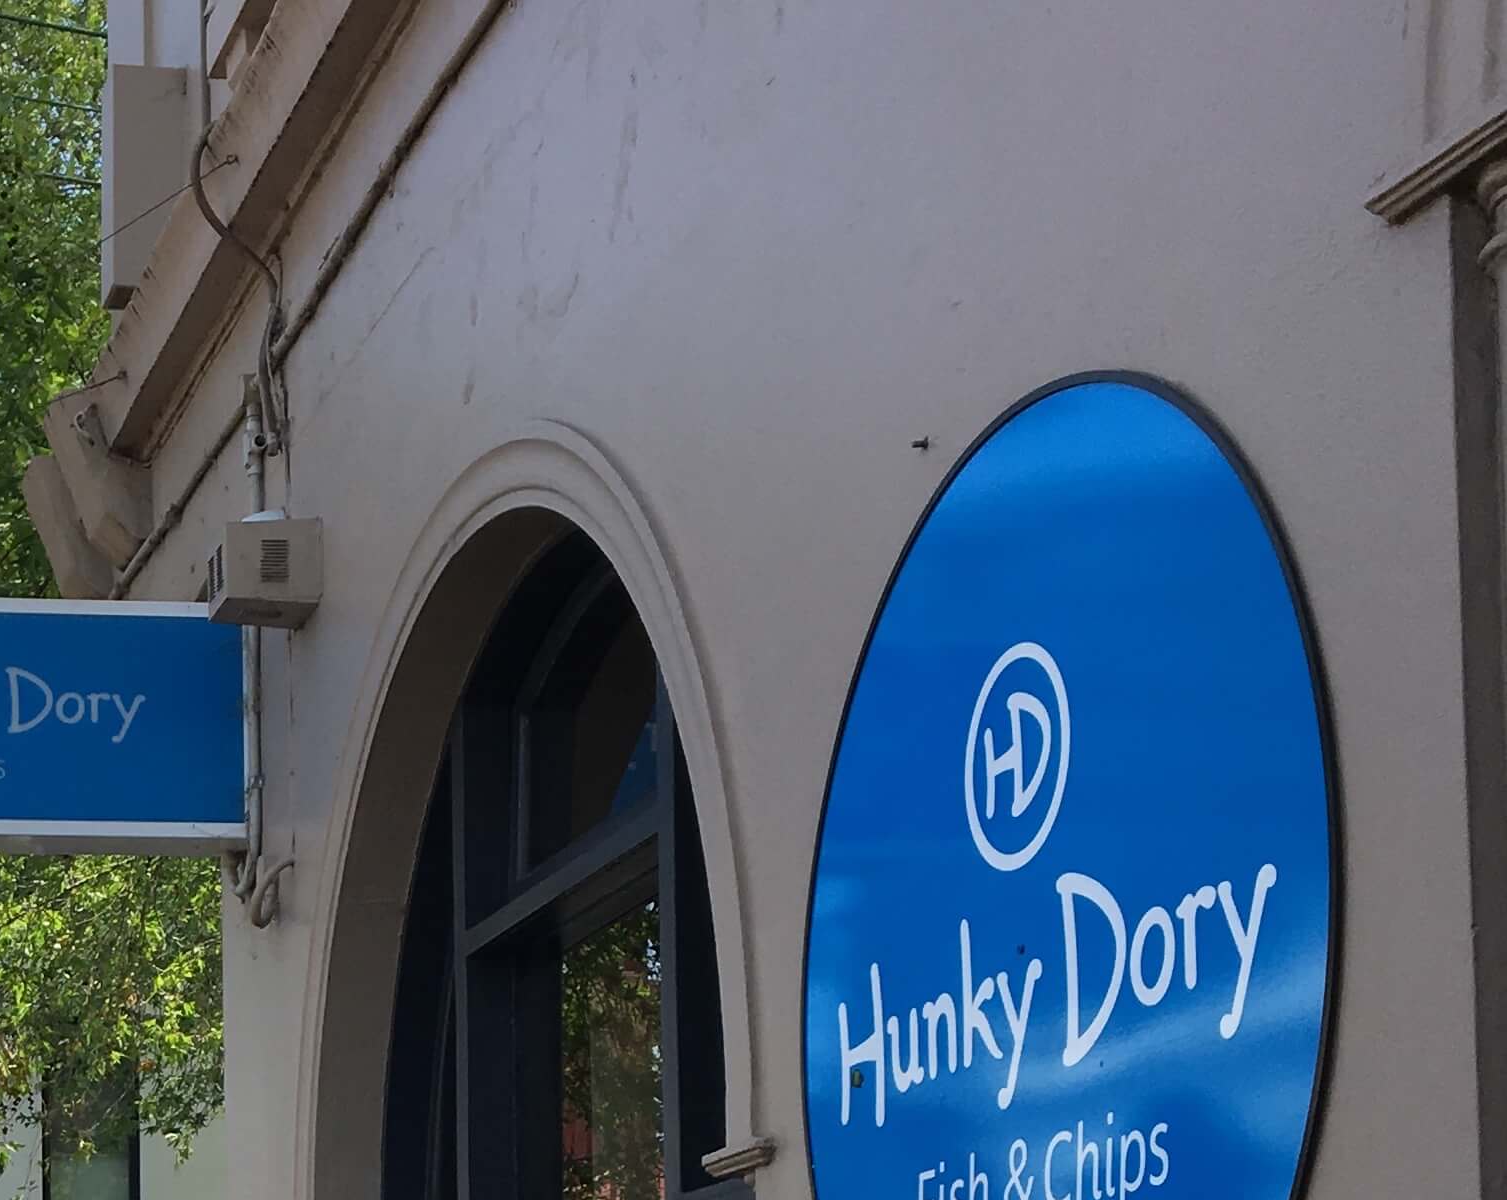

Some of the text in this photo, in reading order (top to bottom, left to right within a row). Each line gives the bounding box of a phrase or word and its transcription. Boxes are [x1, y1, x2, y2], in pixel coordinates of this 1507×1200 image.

[5, 665, 147, 743] Dory
[983, 691, 1052, 820] HD
[838, 863, 1277, 1127] Hunky Dory
